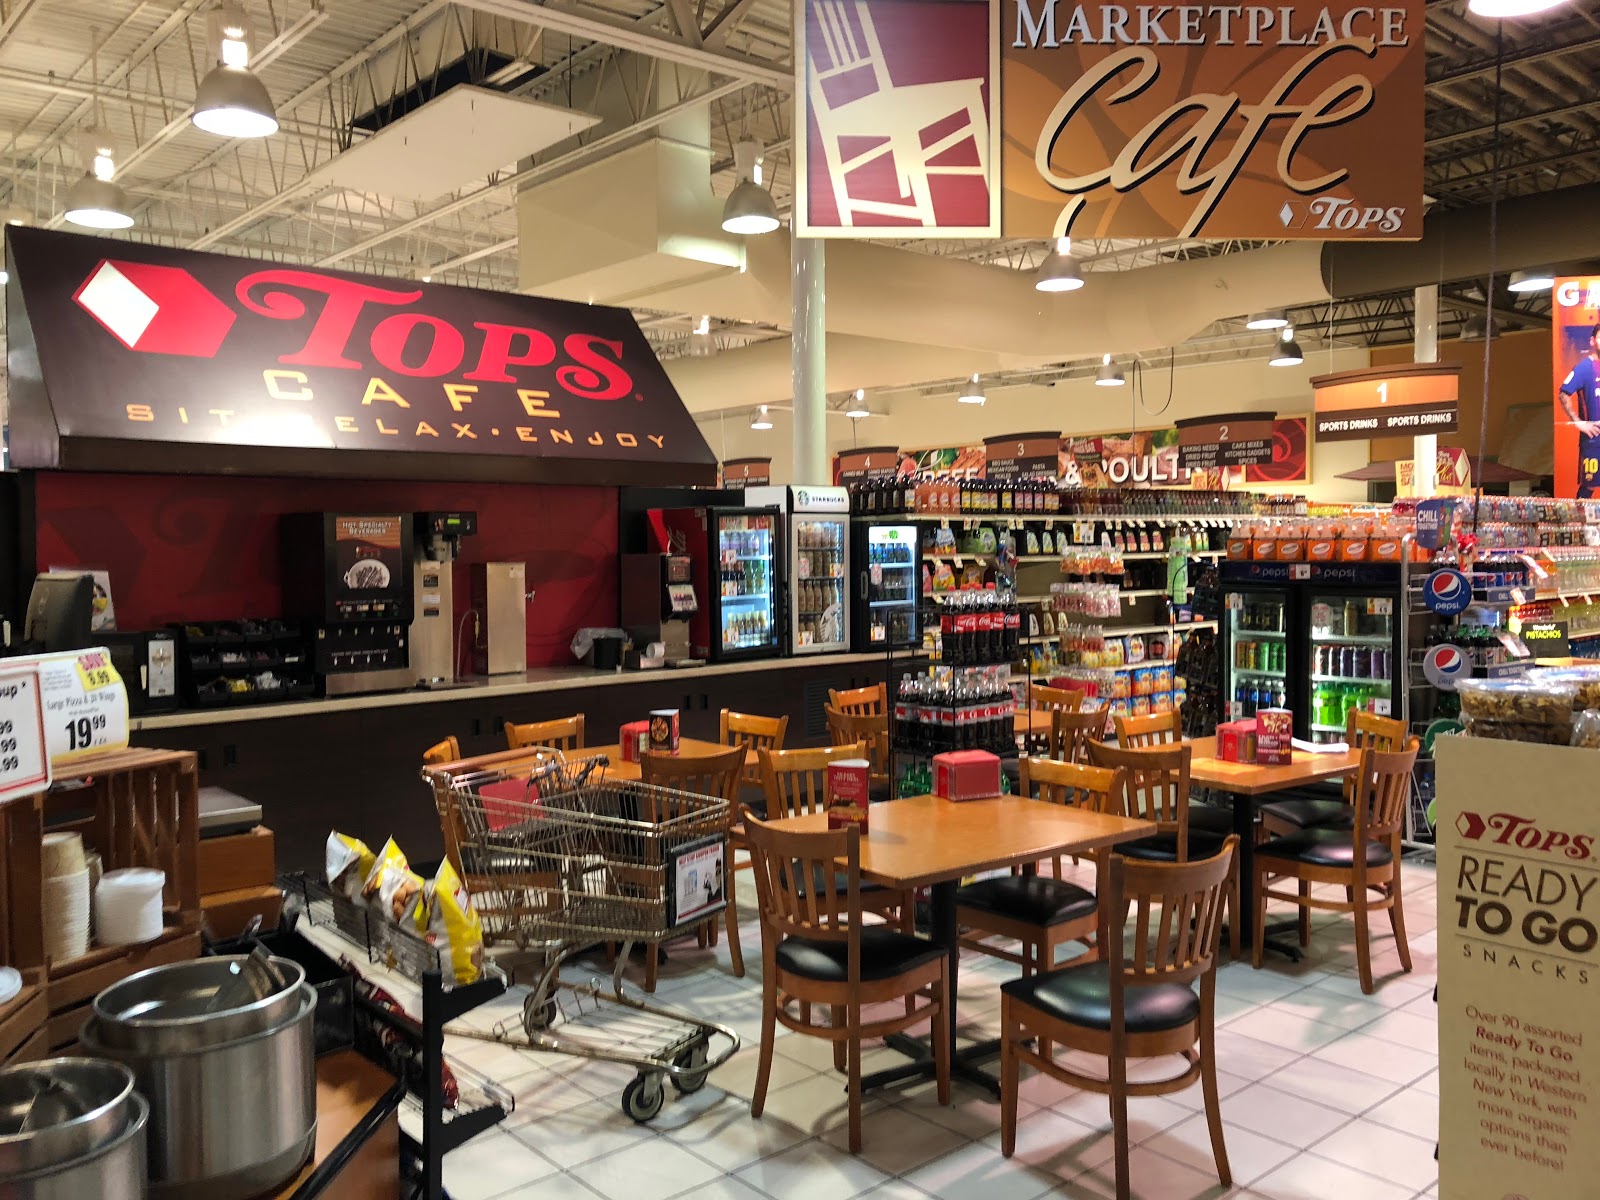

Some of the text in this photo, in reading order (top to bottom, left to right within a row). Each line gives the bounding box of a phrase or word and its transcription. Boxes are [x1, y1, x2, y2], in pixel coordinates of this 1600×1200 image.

[1012, 0, 1411, 50] MARKETPLACE
[263, 368, 562, 420] CAFE
[1376, 381, 1388, 404] 1
[126, 403, 235, 427] SIT
[515, 425, 667, 450] ENJOY
[1318, 417, 1378, 433] SPORTS DRINKS
[1387, 412, 1452, 428] SPORTS DRINKS
[1219, 425, 1229, 441] 2
[1017, 442, 1025, 457] 3
[1182, 443, 1220, 454] BAKING NEEDS
[1231, 440, 1264, 450] CAKE MIXES
[864, 455, 871, 469] 4
[1185, 451, 1217, 461] DRIED FRUIT
[1224, 449, 1247, 459] KITCHEN
[1065, 460, 1081, 485] &
[1185, 459, 1217, 469] DRIED FRUIT
[1583, 457, 1599, 474] 10
[1417, 509, 1439, 522] CHILL
[1262, 566, 1289, 578] pepsi
[1323, 566, 1356, 579] pepsi
[1435, 602, 1459, 611] pepsi
[1525, 629, 1562, 640] PISTACHIOS
[1457, 854, 1598, 912] READY
[1455, 894, 1599, 954] TO GO
[1463, 943, 1589, 985] SNACKS
[1465, 1004, 1583, 1048] Over 90 assorted
[1475, 1025, 1574, 1063] Ready To Go
[1512, 1055, 1581, 1085] packaged
[1464, 1056, 1588, 1104] locally in Western
[1472, 1077, 1578, 1121] New York, with
[1477, 1099, 1570, 1138] more organic
[1479, 1117, 1568, 1155] options than
[1480, 1136, 1509, 1153] ever
